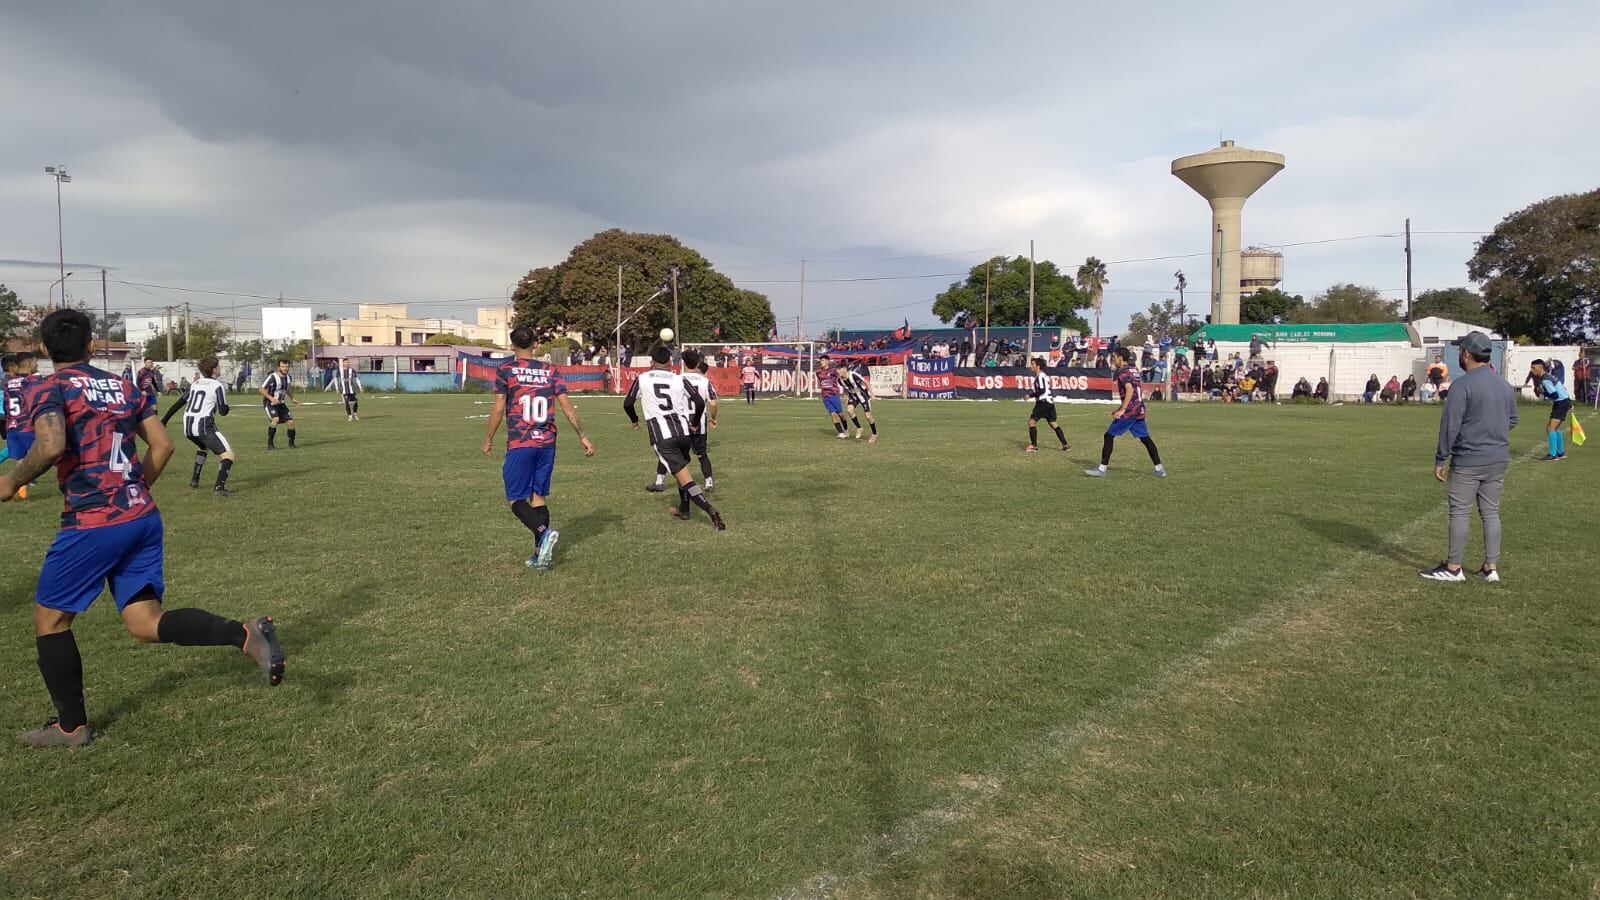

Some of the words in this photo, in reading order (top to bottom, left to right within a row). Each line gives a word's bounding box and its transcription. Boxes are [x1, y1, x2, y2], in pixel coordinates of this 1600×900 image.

[512, 367, 551, 376] STREET
[941, 361, 949, 371] LA
[69, 377, 125, 391] STREET
[516, 375, 548, 384] WEAR
[932, 377, 940, 387] ES
[942, 376, 949, 386] NO
[975, 375, 1003, 389] LOS
[1015, 375, 1088, 390] TIEROS
[83, 389, 126, 404] WEAR
[186, 389, 206, 413] 10
[653, 383, 673, 411] 5
[9, 397, 21, 416] 5
[519, 394, 548, 423] 10
[109, 431, 132, 480] 4
